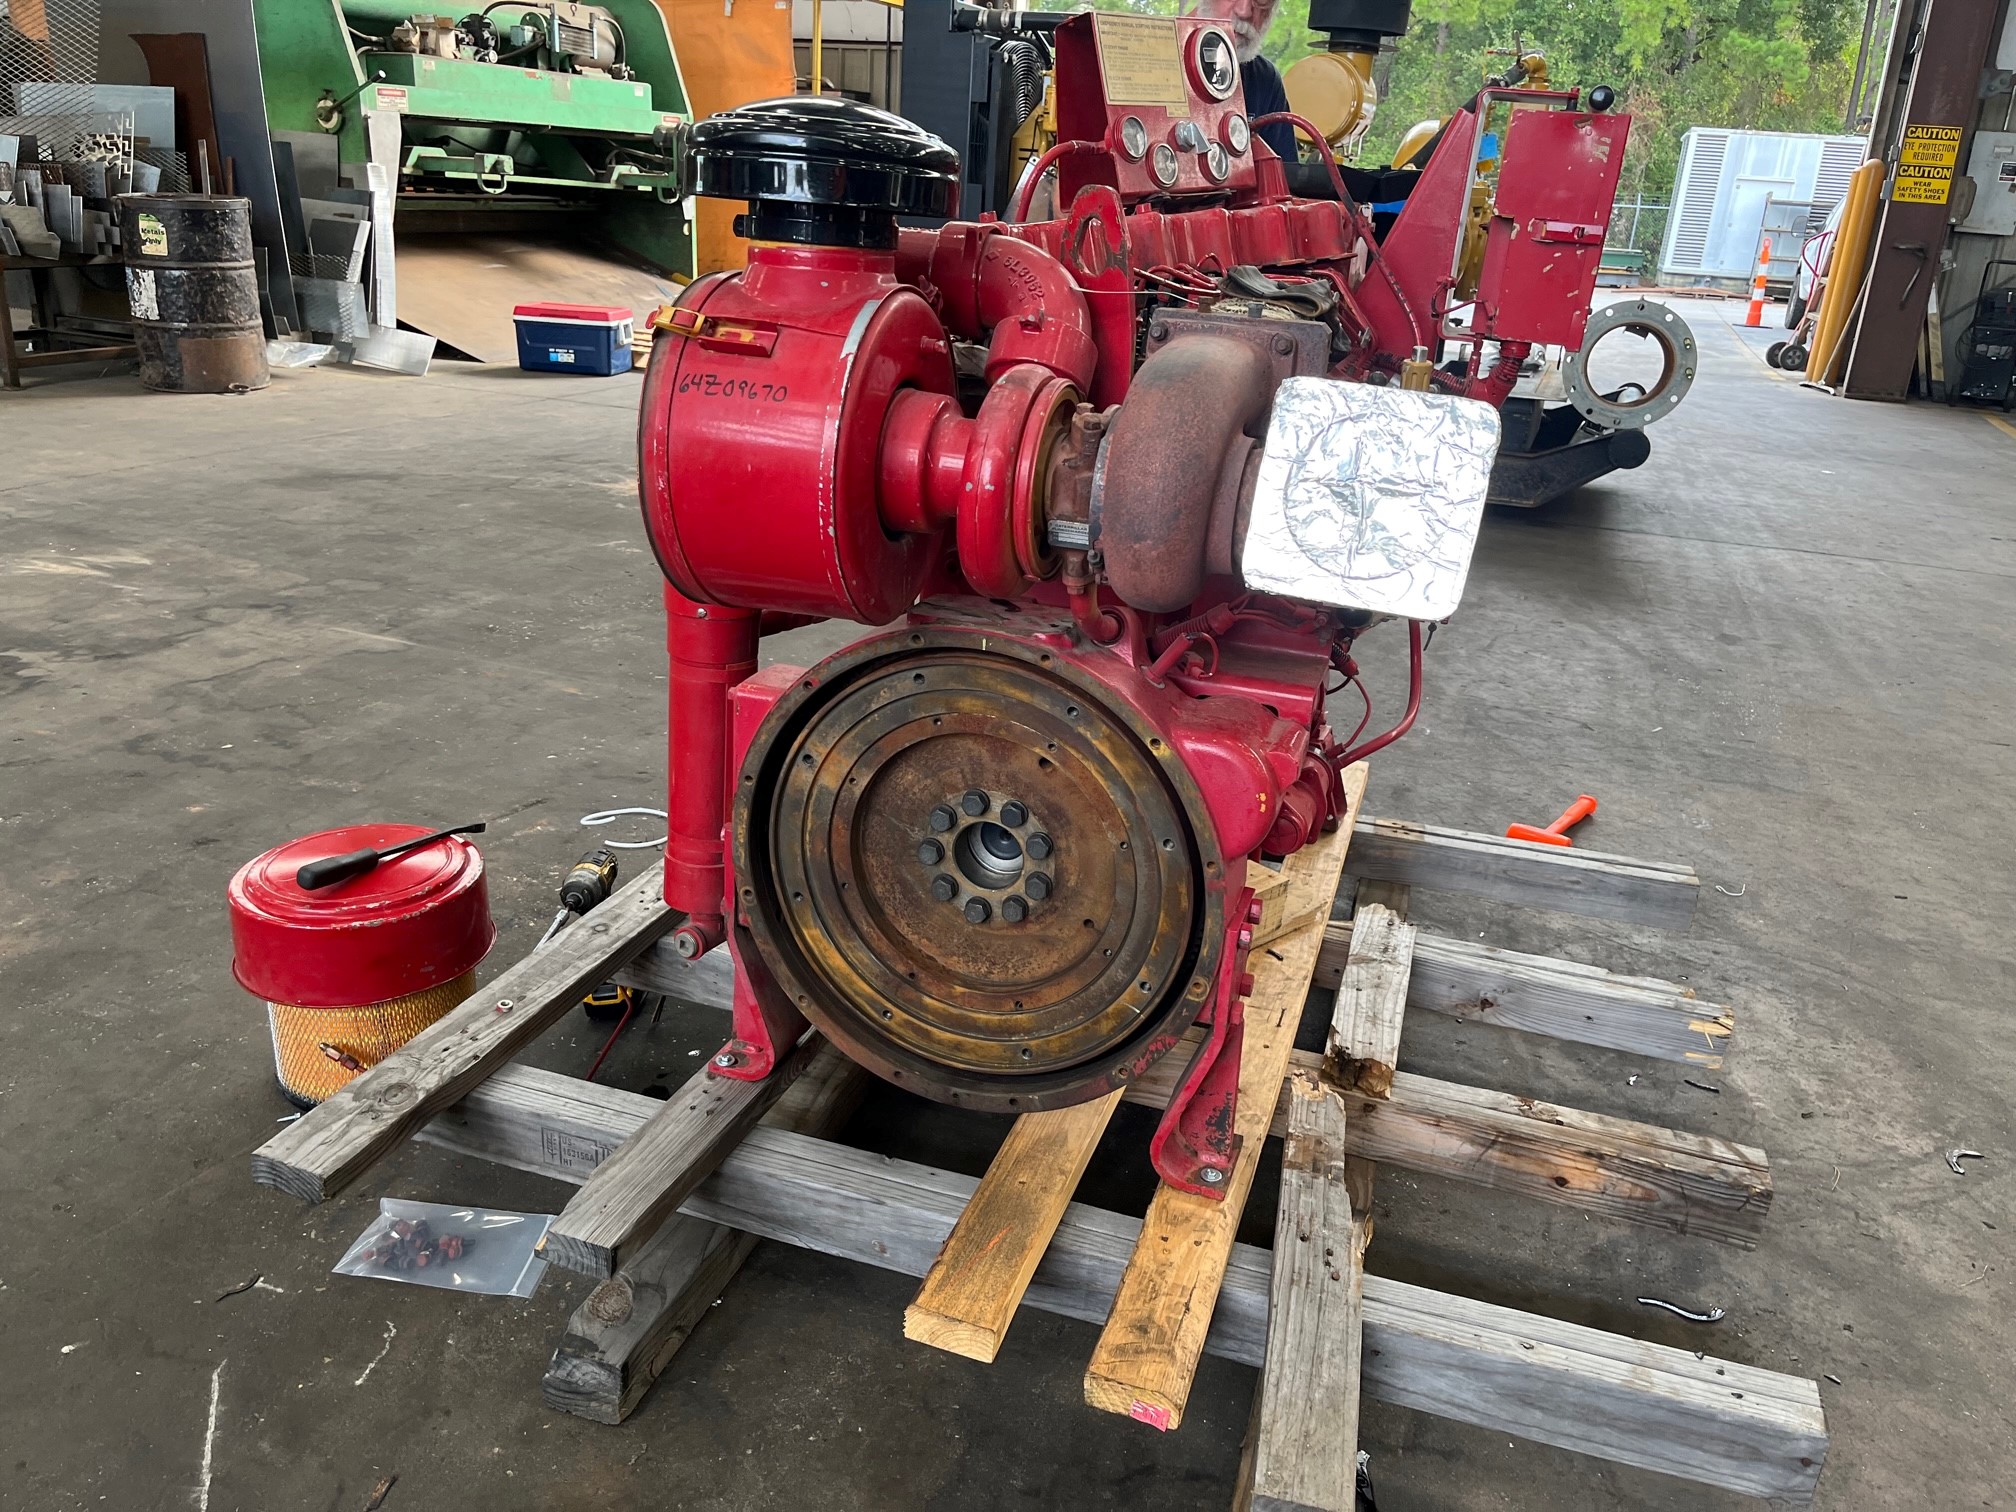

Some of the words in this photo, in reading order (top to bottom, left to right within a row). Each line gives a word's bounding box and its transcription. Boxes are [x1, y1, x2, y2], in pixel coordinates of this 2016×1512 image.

[1907, 127, 1960, 140] CAUTION
[1904, 142, 1915, 151] EYE
[1918, 143, 1957, 153] PROTECTION
[1913, 152, 1944, 162] REQUIRED
[1899, 165, 1952, 179] CAUTION
[679, 373, 788, 402] 64Z09670
